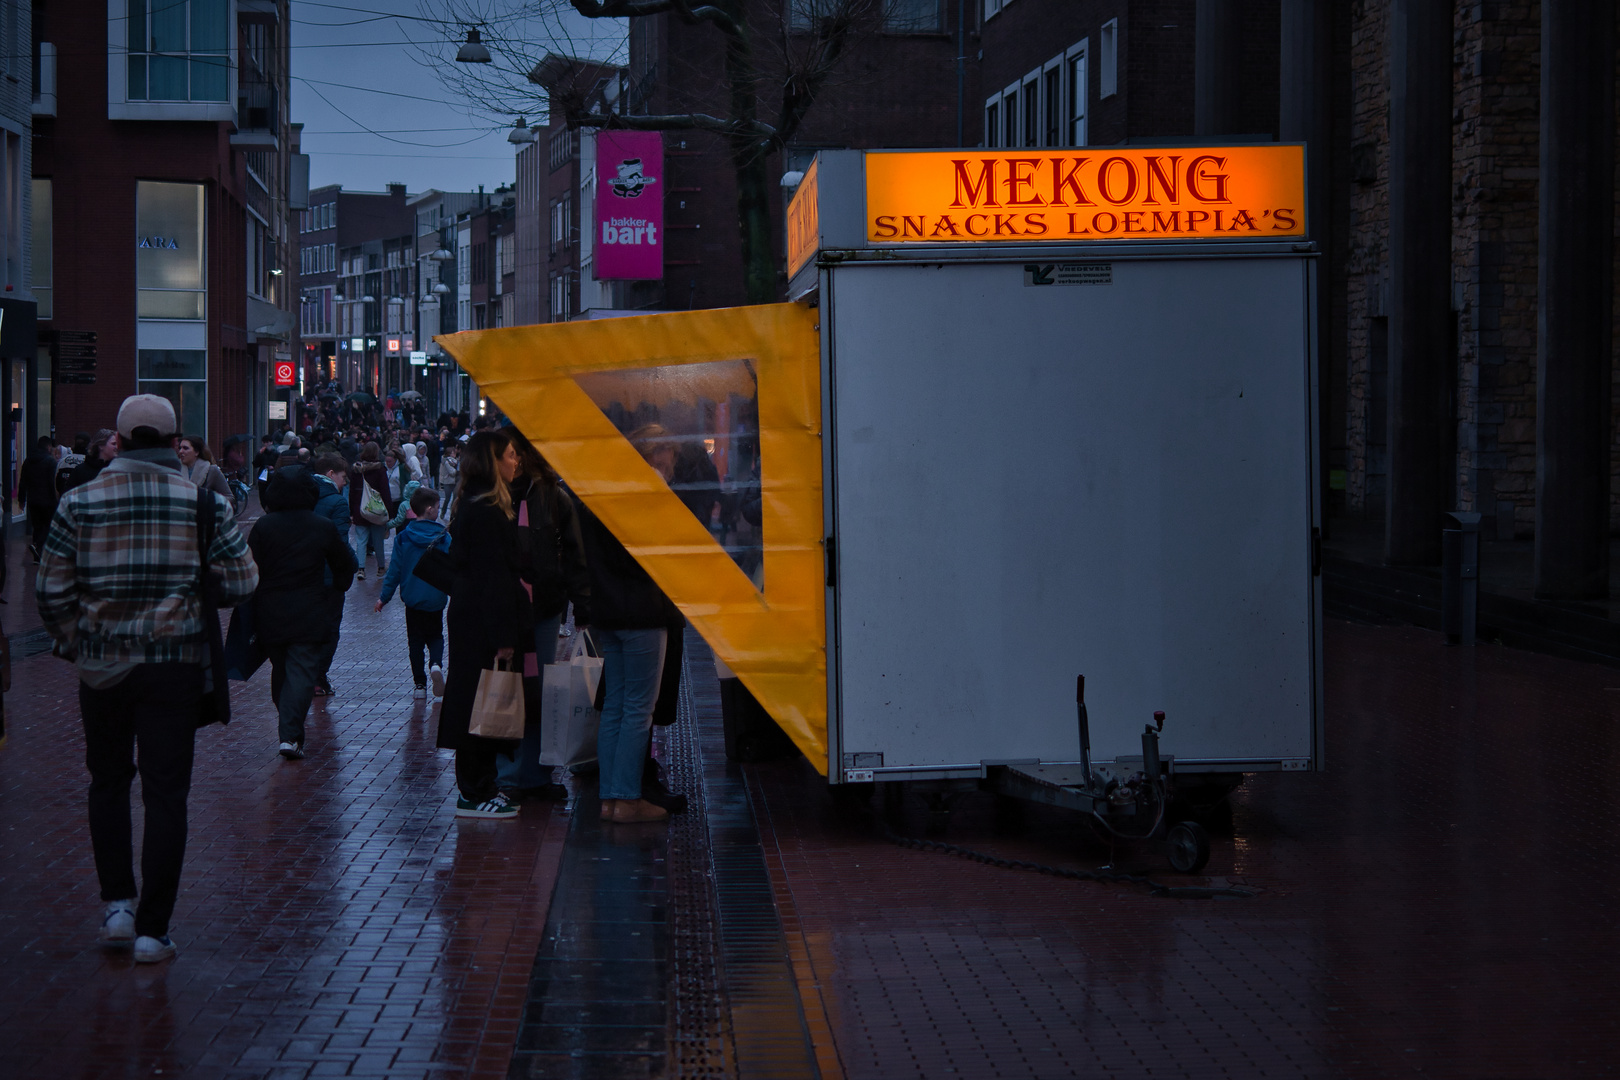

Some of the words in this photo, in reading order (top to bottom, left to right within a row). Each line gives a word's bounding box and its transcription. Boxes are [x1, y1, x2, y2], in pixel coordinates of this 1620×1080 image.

[949, 155, 1233, 210] MEKONG
[611, 217, 647, 226] bakker
[873, 211, 1049, 240] SNACKS
[1066, 207, 1298, 236] LOEMPIA'S
[602, 221, 657, 246] bart
[138, 236, 180, 250] ARA
[1057, 264, 1112, 272] VREDEVELD
[573, 706, 600, 718] PRI
